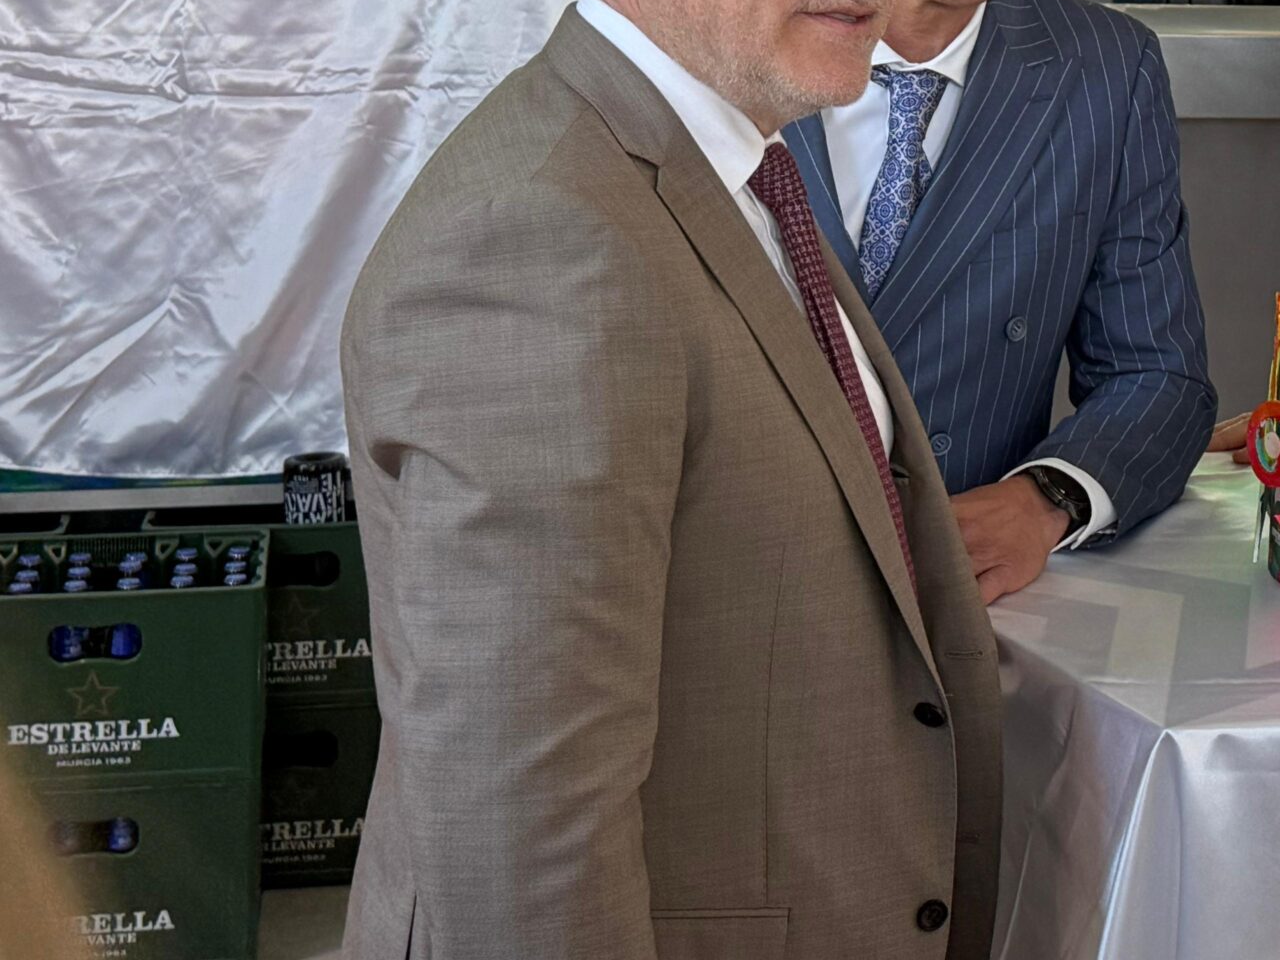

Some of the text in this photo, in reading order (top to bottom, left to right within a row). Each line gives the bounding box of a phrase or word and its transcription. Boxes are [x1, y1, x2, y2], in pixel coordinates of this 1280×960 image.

[273, 658, 338, 672] LEVANTE
[8, 716, 180, 745] ESTRELLA
[48, 739, 142, 756] DE LEVANTE
[56, 757, 102, 768] MURCIA
